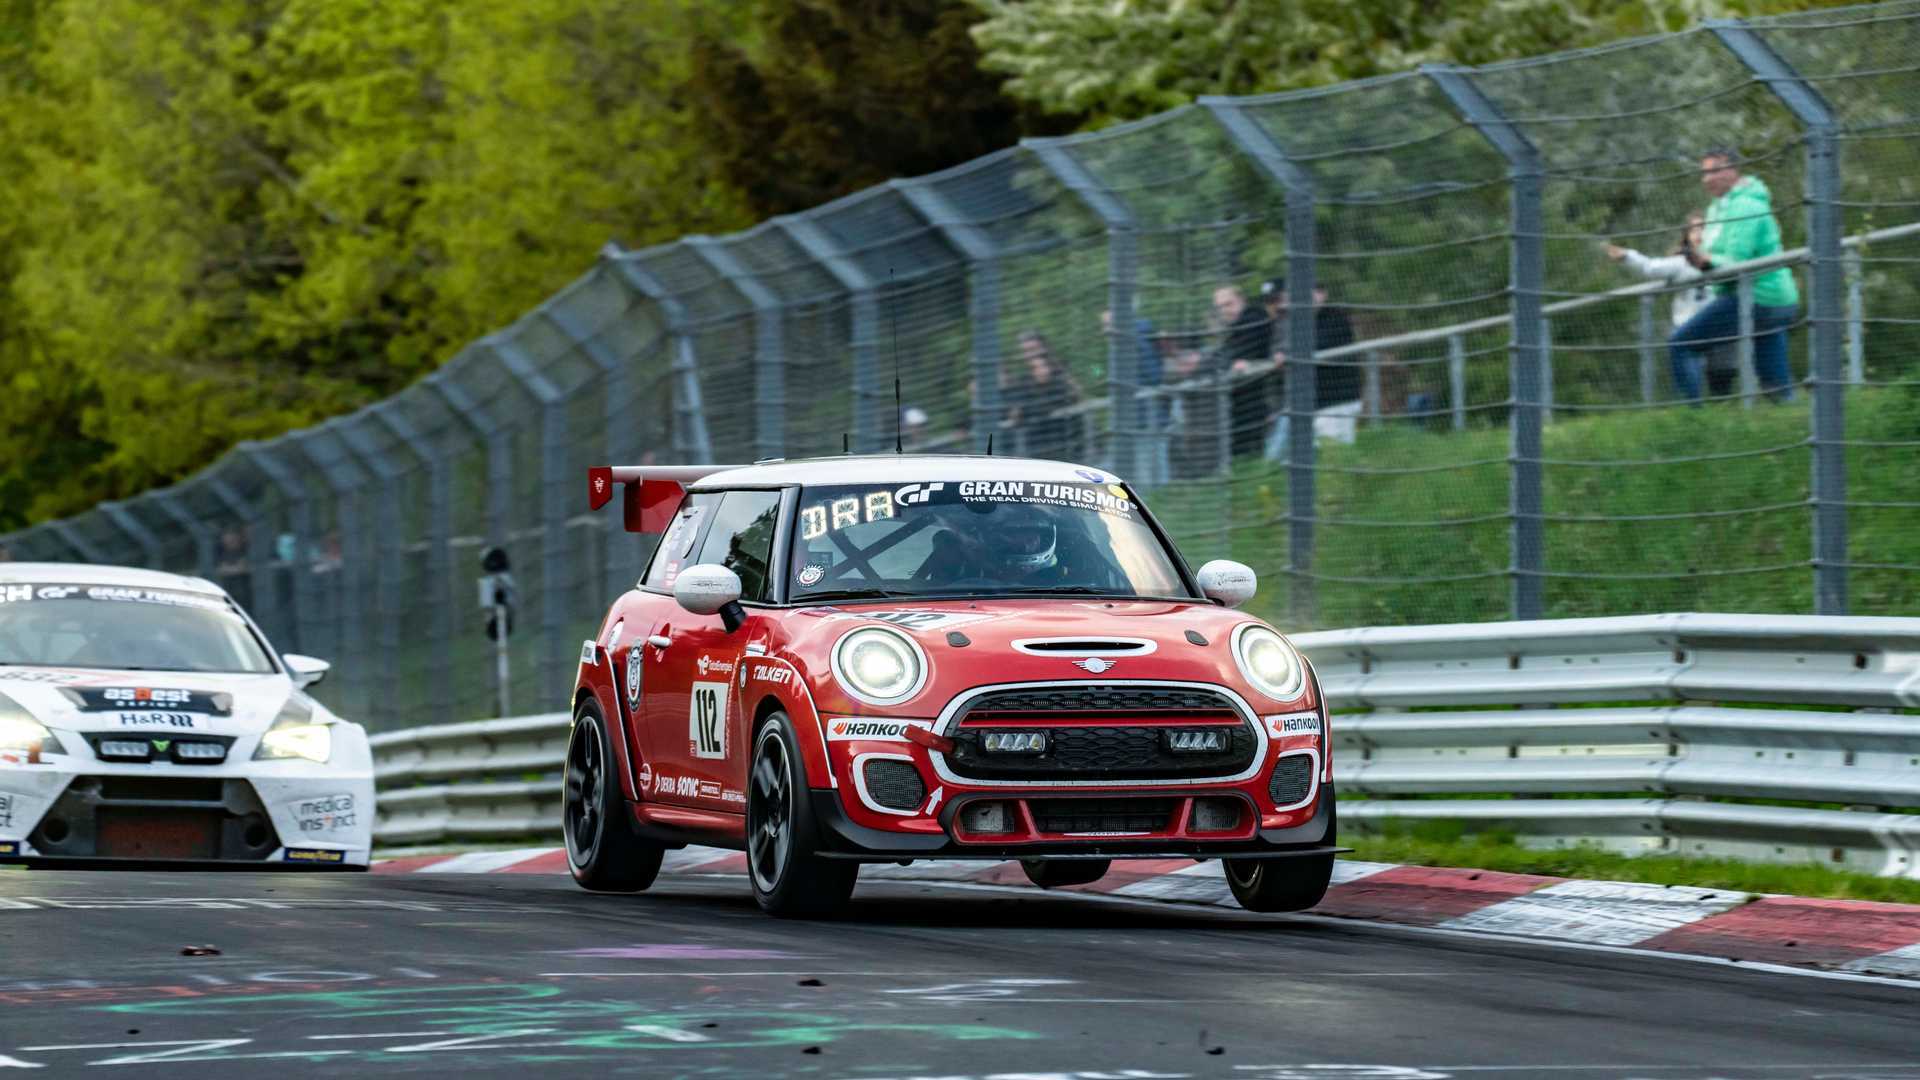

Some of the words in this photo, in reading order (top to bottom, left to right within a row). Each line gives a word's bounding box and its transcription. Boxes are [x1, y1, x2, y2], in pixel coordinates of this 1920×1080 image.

[959, 482, 1024, 496] GRAN
[1031, 483, 1130, 511] TURISMO
[1021, 497, 1068, 506] DRIVING
[1069, 501, 1132, 519] SIMULATOR
[696, 689, 721, 752] 112
[845, 723, 910, 736] Hankoo
